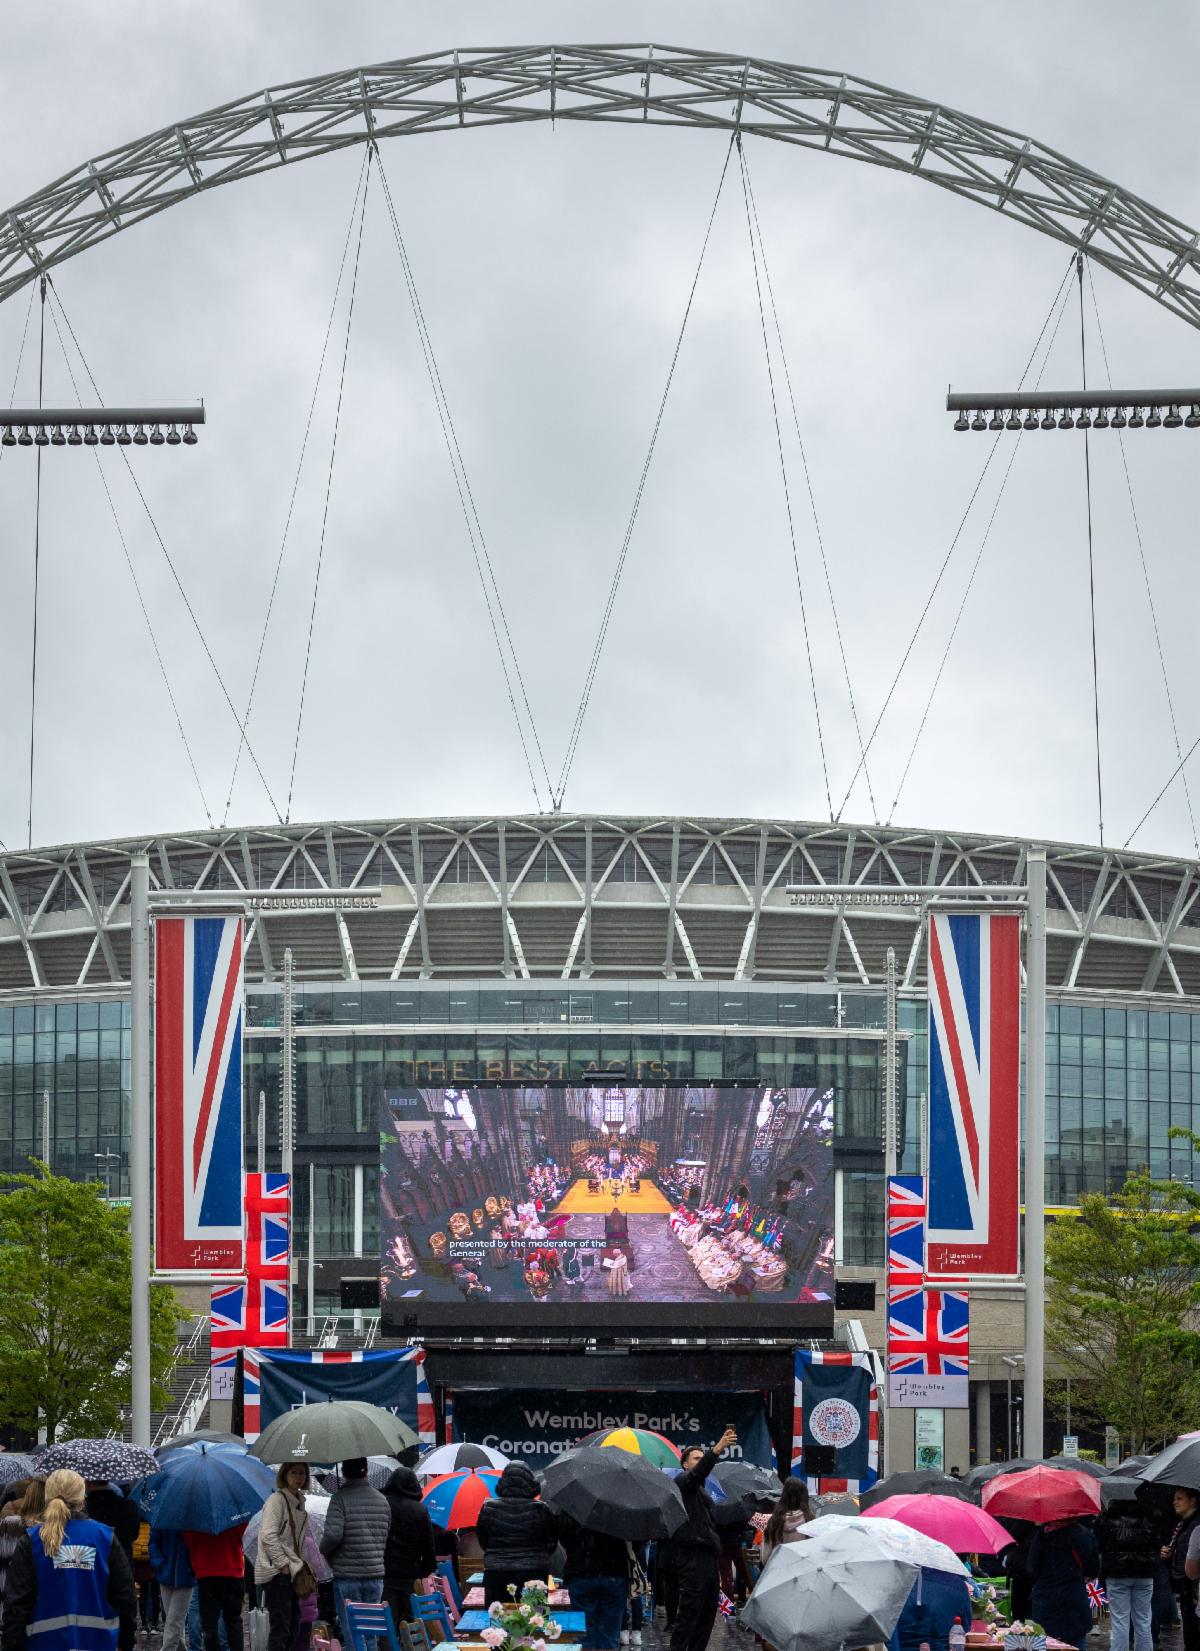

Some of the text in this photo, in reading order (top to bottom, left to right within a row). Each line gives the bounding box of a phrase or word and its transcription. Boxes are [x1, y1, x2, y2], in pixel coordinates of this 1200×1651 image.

[405, 1059, 470, 1080] THE
[486, 1059, 567, 1080] BEST
[449, 1240, 607, 1249] presented by the moderator of the
[449, 1249, 486, 1257] General
[523, 1410, 701, 1432] Wembley Park's
